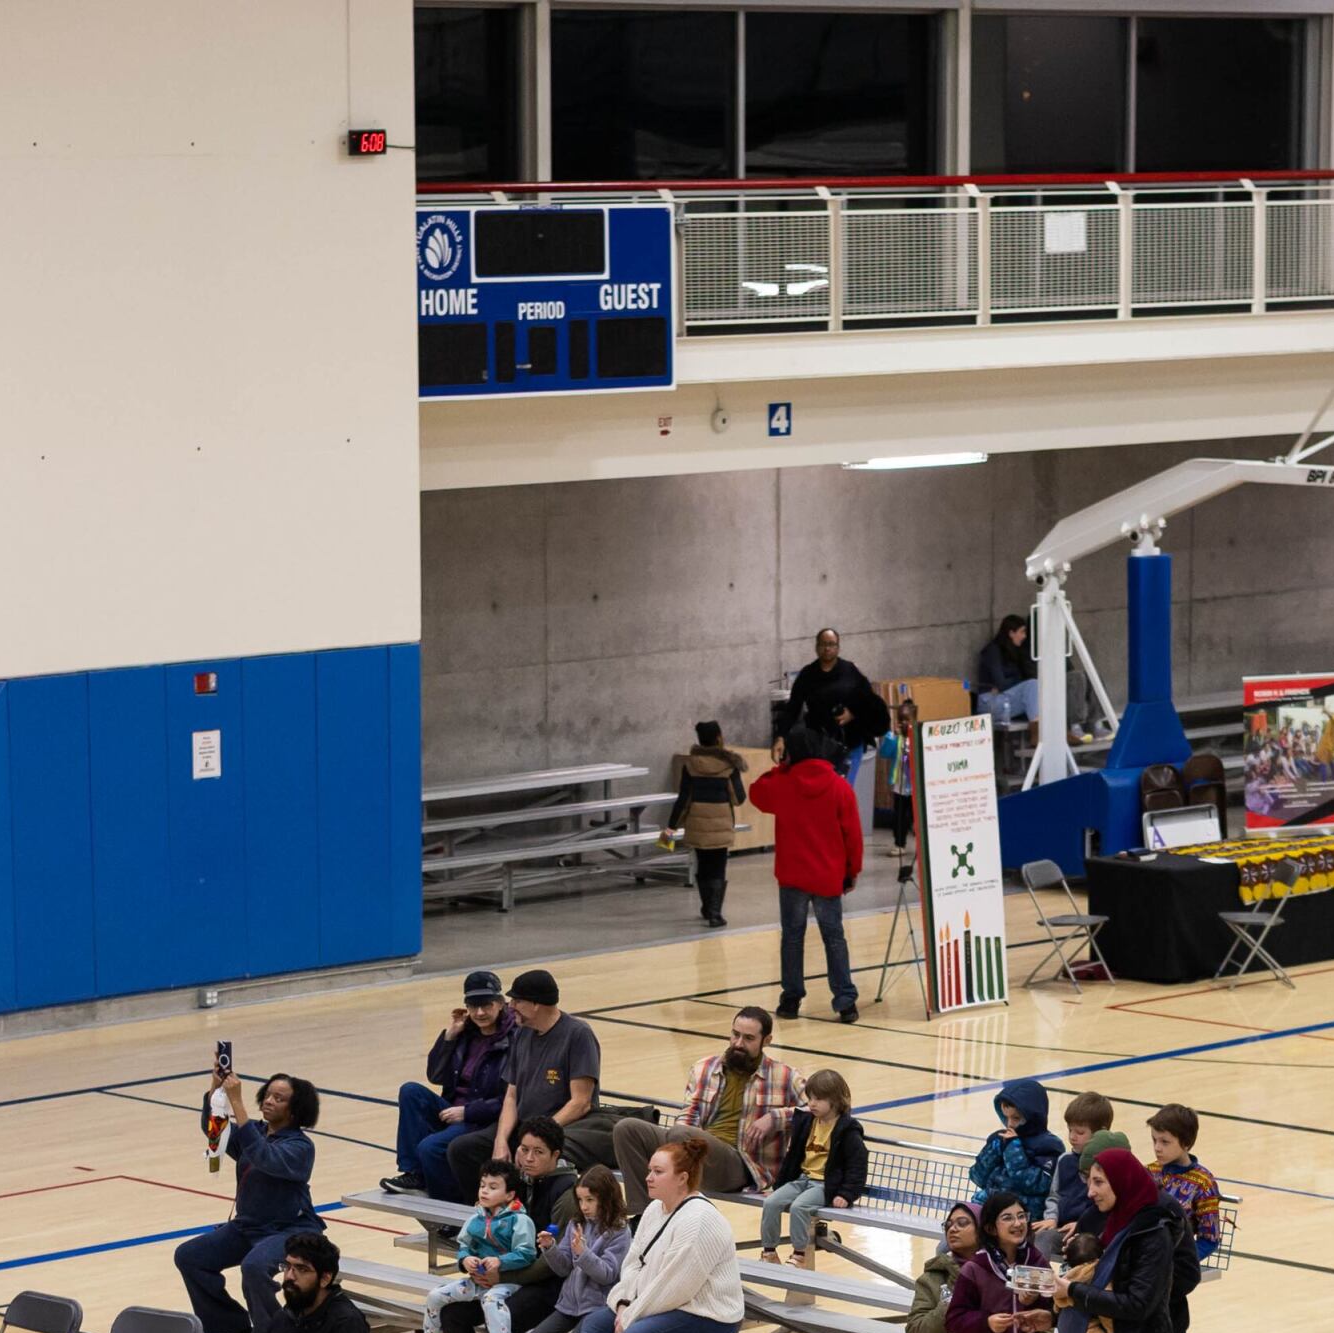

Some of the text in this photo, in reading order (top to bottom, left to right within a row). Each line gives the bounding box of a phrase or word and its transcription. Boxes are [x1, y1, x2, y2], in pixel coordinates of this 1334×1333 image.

[420, 288, 478, 316] HOME
[517, 301, 565, 320] PERIOD
[599, 283, 661, 311] GUEST
[771, 406, 789, 432] 4
